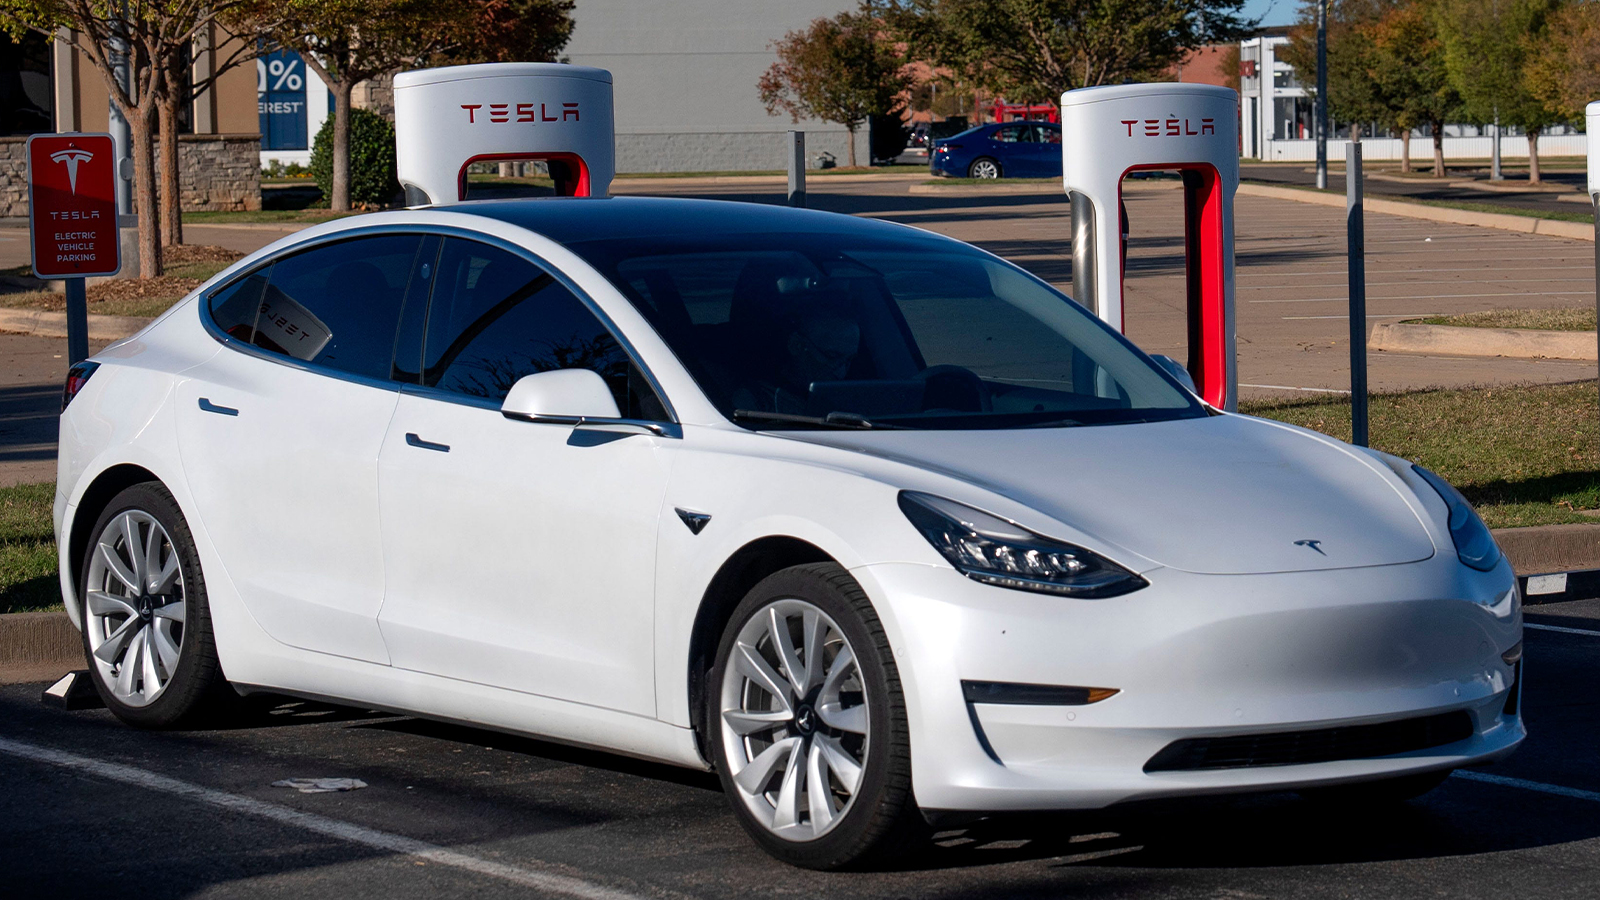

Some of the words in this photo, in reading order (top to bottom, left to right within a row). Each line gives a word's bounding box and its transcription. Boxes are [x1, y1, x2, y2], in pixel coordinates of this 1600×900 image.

[460, 102, 580, 124] TESLA
[1120, 118, 1215, 137] TESLA
[50, 210, 100, 220] TESLA
[54, 231, 96, 241] ELECTRIC
[57, 242, 95, 251] VEHICLE
[56, 253, 96, 262] PARKING
